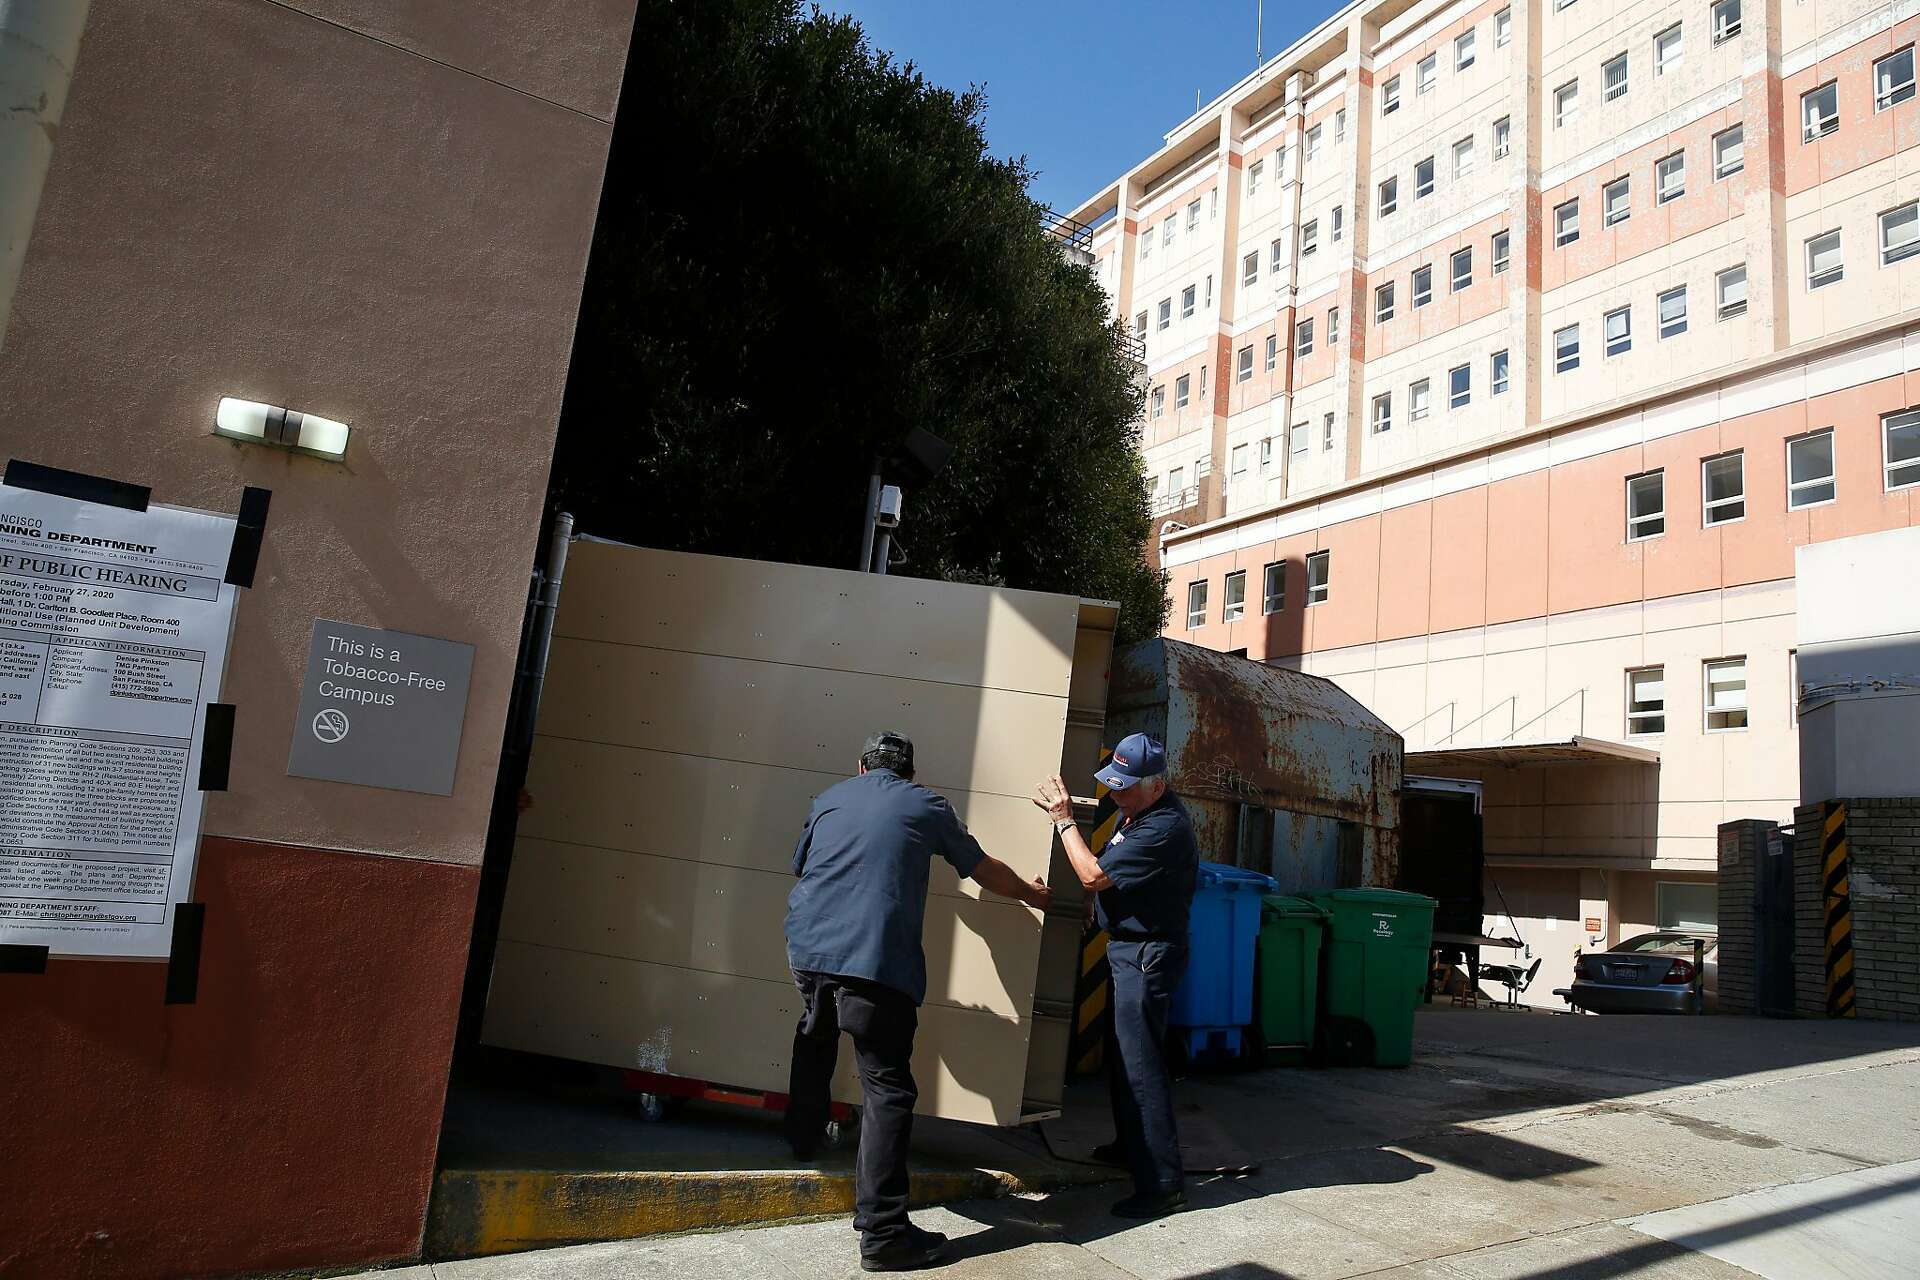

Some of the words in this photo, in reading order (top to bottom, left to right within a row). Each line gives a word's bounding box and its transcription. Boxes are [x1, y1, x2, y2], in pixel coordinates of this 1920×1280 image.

[47, 532, 157, 554] DEPARTMENT
[18, 557, 92, 579] PUBLIC
[96, 567, 188, 592] HEARING
[0, 587, 31, 598] before
[34, 592, 53, 601] 1:00
[56, 595, 71, 603] PM
[33, 582, 75, 595] February
[76, 588, 90, 597] 27,
[92, 590, 114, 599] 2020
[24, 600, 36, 609] Dr.
[38, 602, 68, 613] Carlton
[80, 607, 114, 618] Goodlett
[115, 611, 139, 622] Place,
[140, 615, 165, 624] Room
[165, 618, 180, 627] 400
[20, 619, 79, 633] Commission
[35, 611, 53, 620] Use
[55, 614, 96, 626] (Planned
[98, 619, 117, 628] Unit
[119, 621, 180, 637] Development)
[55, 637, 112, 649] APPLICANT
[115, 643, 186, 657] INFORMATION
[327, 635, 365, 656] This
[370, 643, 384, 659] is
[389, 651, 400, 662] a
[3, 650, 41, 659] addresses
[3, 656, 38, 666] California
[116, 654, 139, 663] Denise
[141, 657, 170, 667] Pinkston
[51, 662, 80, 670] Applicant
[115, 661, 131, 669] TMG
[132, 663, 160, 672] Partners
[127, 670, 145, 678] Bush
[146, 672, 166, 680] Street
[322, 657, 446, 691] Tobacco-Free
[319, 680, 395, 706] Campus
[8, 724, 79, 737] DESCRIPTION
[49, 739, 78, 749] Planning
[28, 773, 51, 782] Zoning
[52, 775, 79, 783] Districts
[1, 779, 37, 788] residential
[56, 783, 86, 792] including
[25, 789, 50, 797] parcels
[106, 794, 127, 802] blocks
[5, 801, 24, 809] Code
[25, 803, 54, 811] Sections
[67, 820, 97, 828] Approval
[65, 827, 90, 835] Section
[43, 883, 73, 892] Planning
[20, 903, 73, 911] DEPARTMENT
